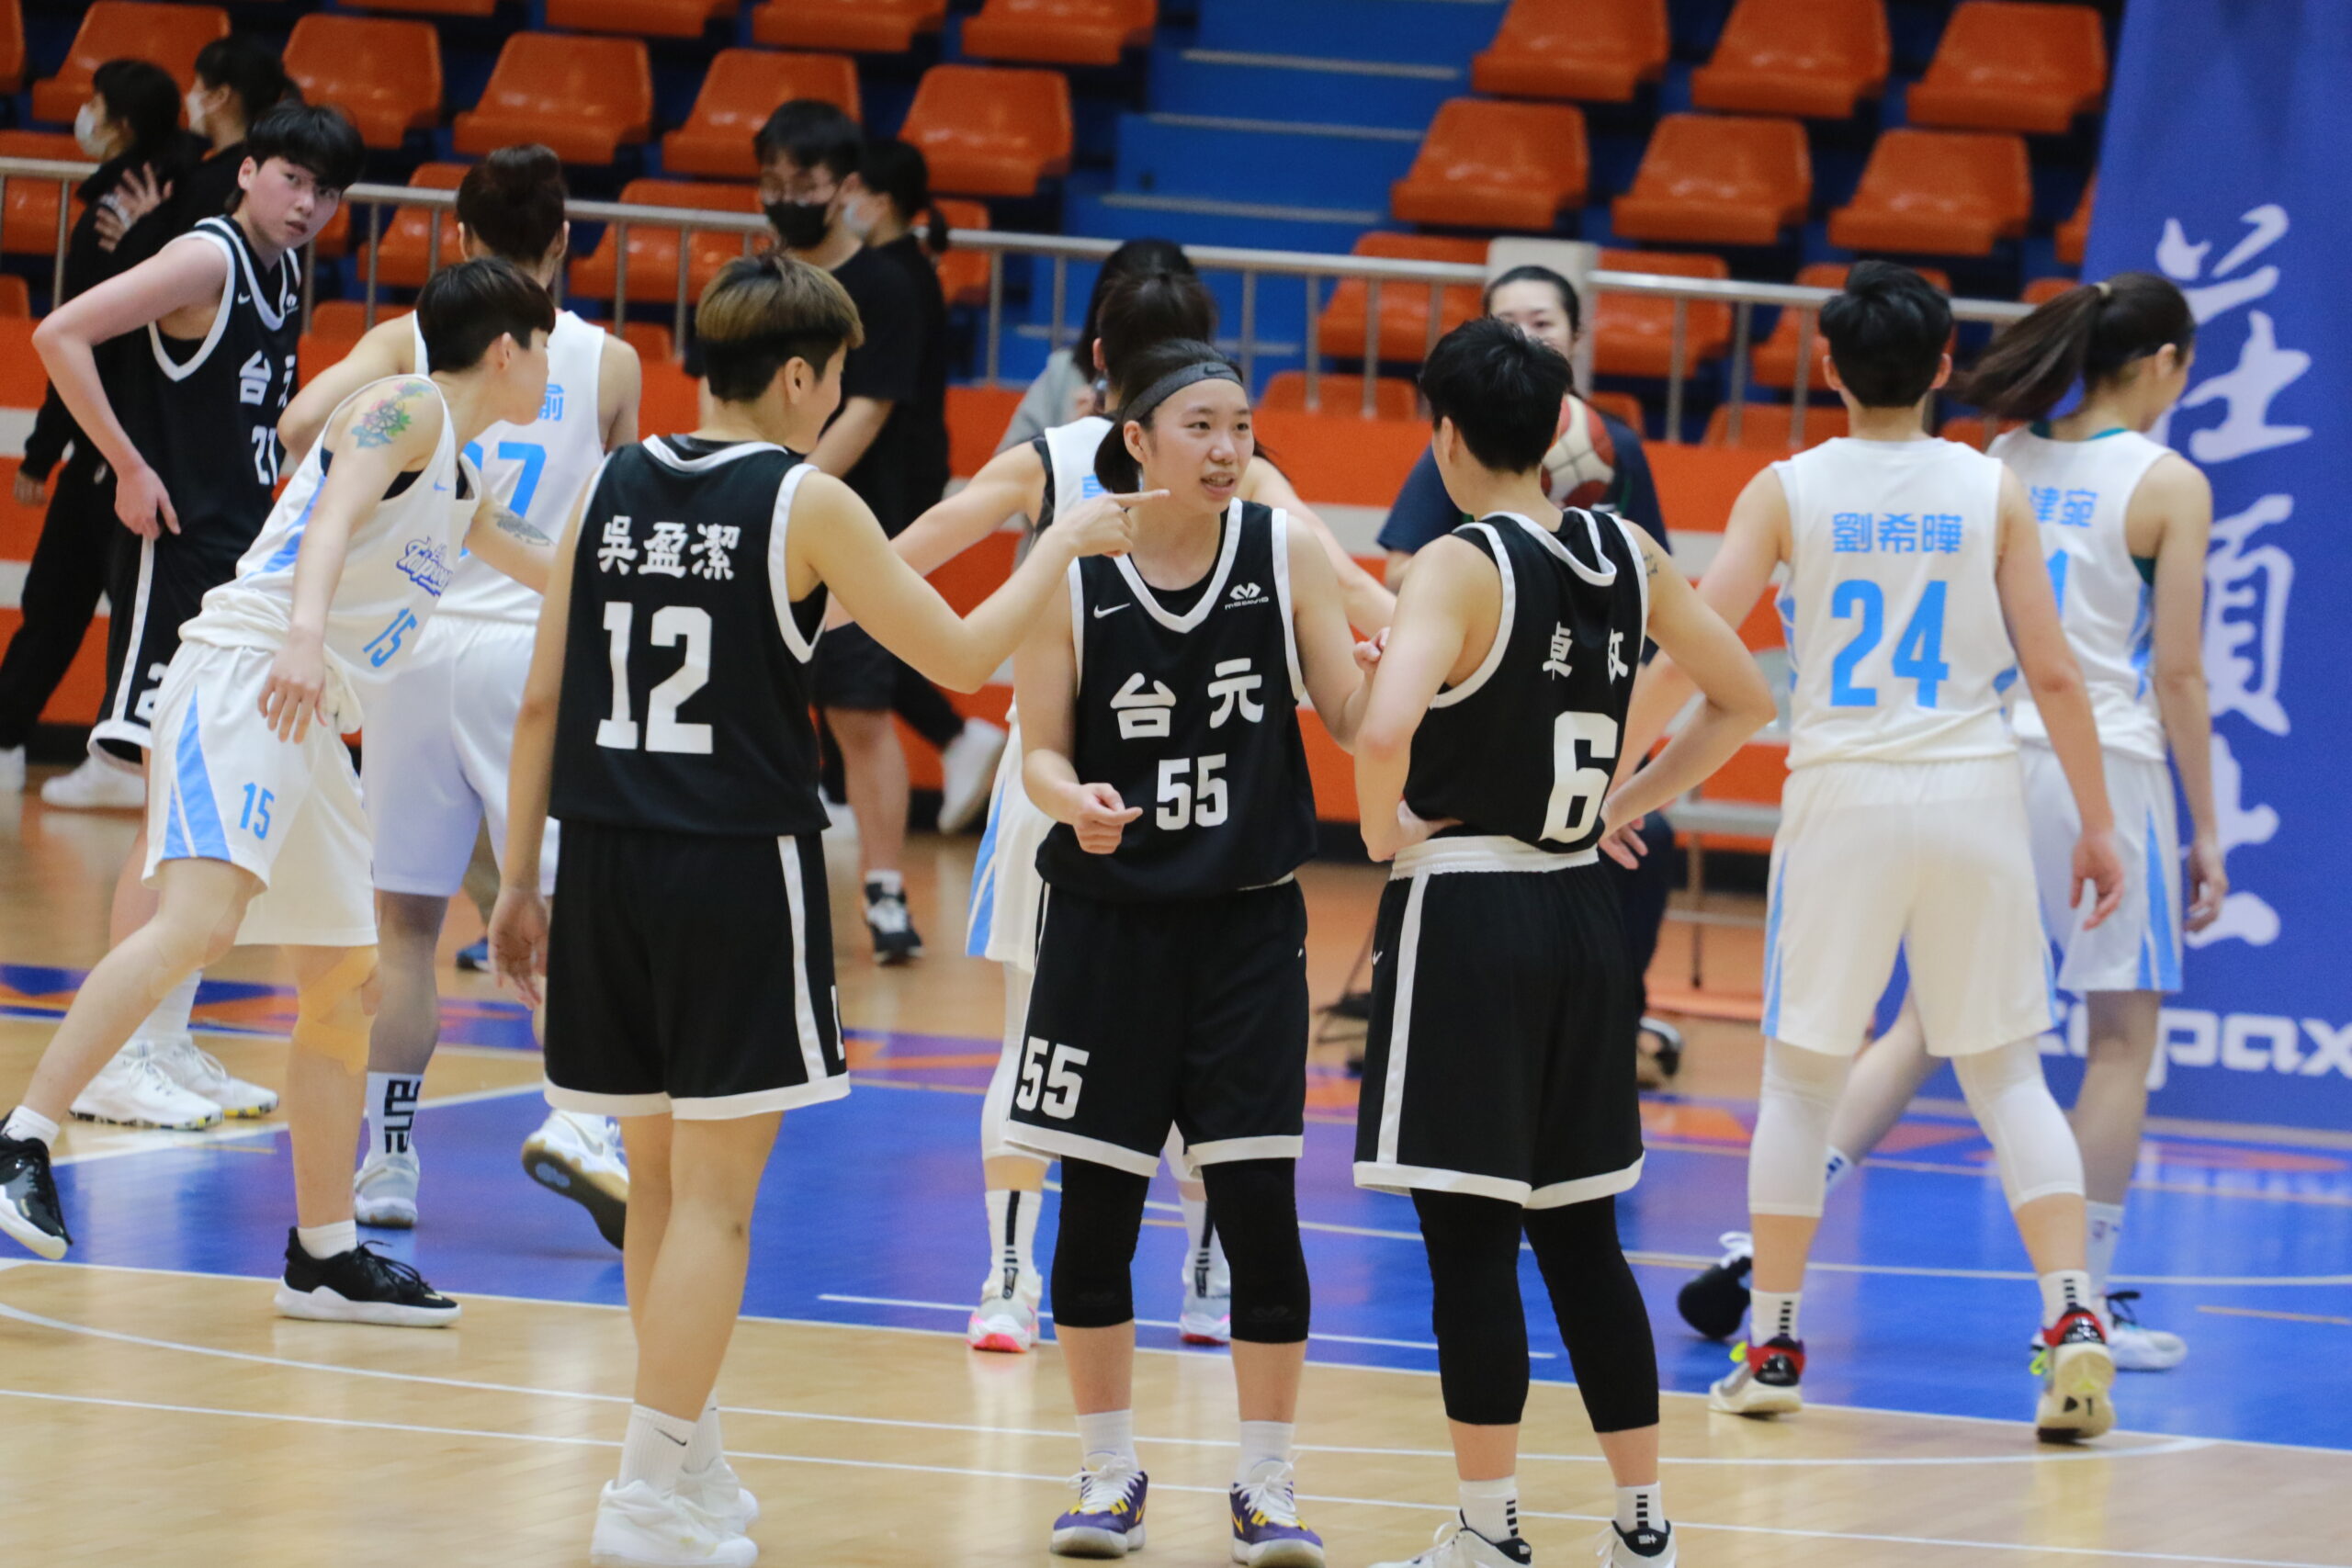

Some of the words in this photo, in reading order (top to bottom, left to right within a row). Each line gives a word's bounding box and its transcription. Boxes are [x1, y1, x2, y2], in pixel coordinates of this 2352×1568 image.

[597, 514, 741, 581] 吳盈潔
[363, 607, 418, 668] 15
[595, 601, 713, 754] 12
[1830, 579, 1950, 708] 24
[1110, 658, 1264, 739] 台元
[240, 783, 275, 840] 15
[1156, 752, 1228, 830] 55
[1538, 710, 1619, 844] 6
[1015, 1035, 1091, 1120] 55
